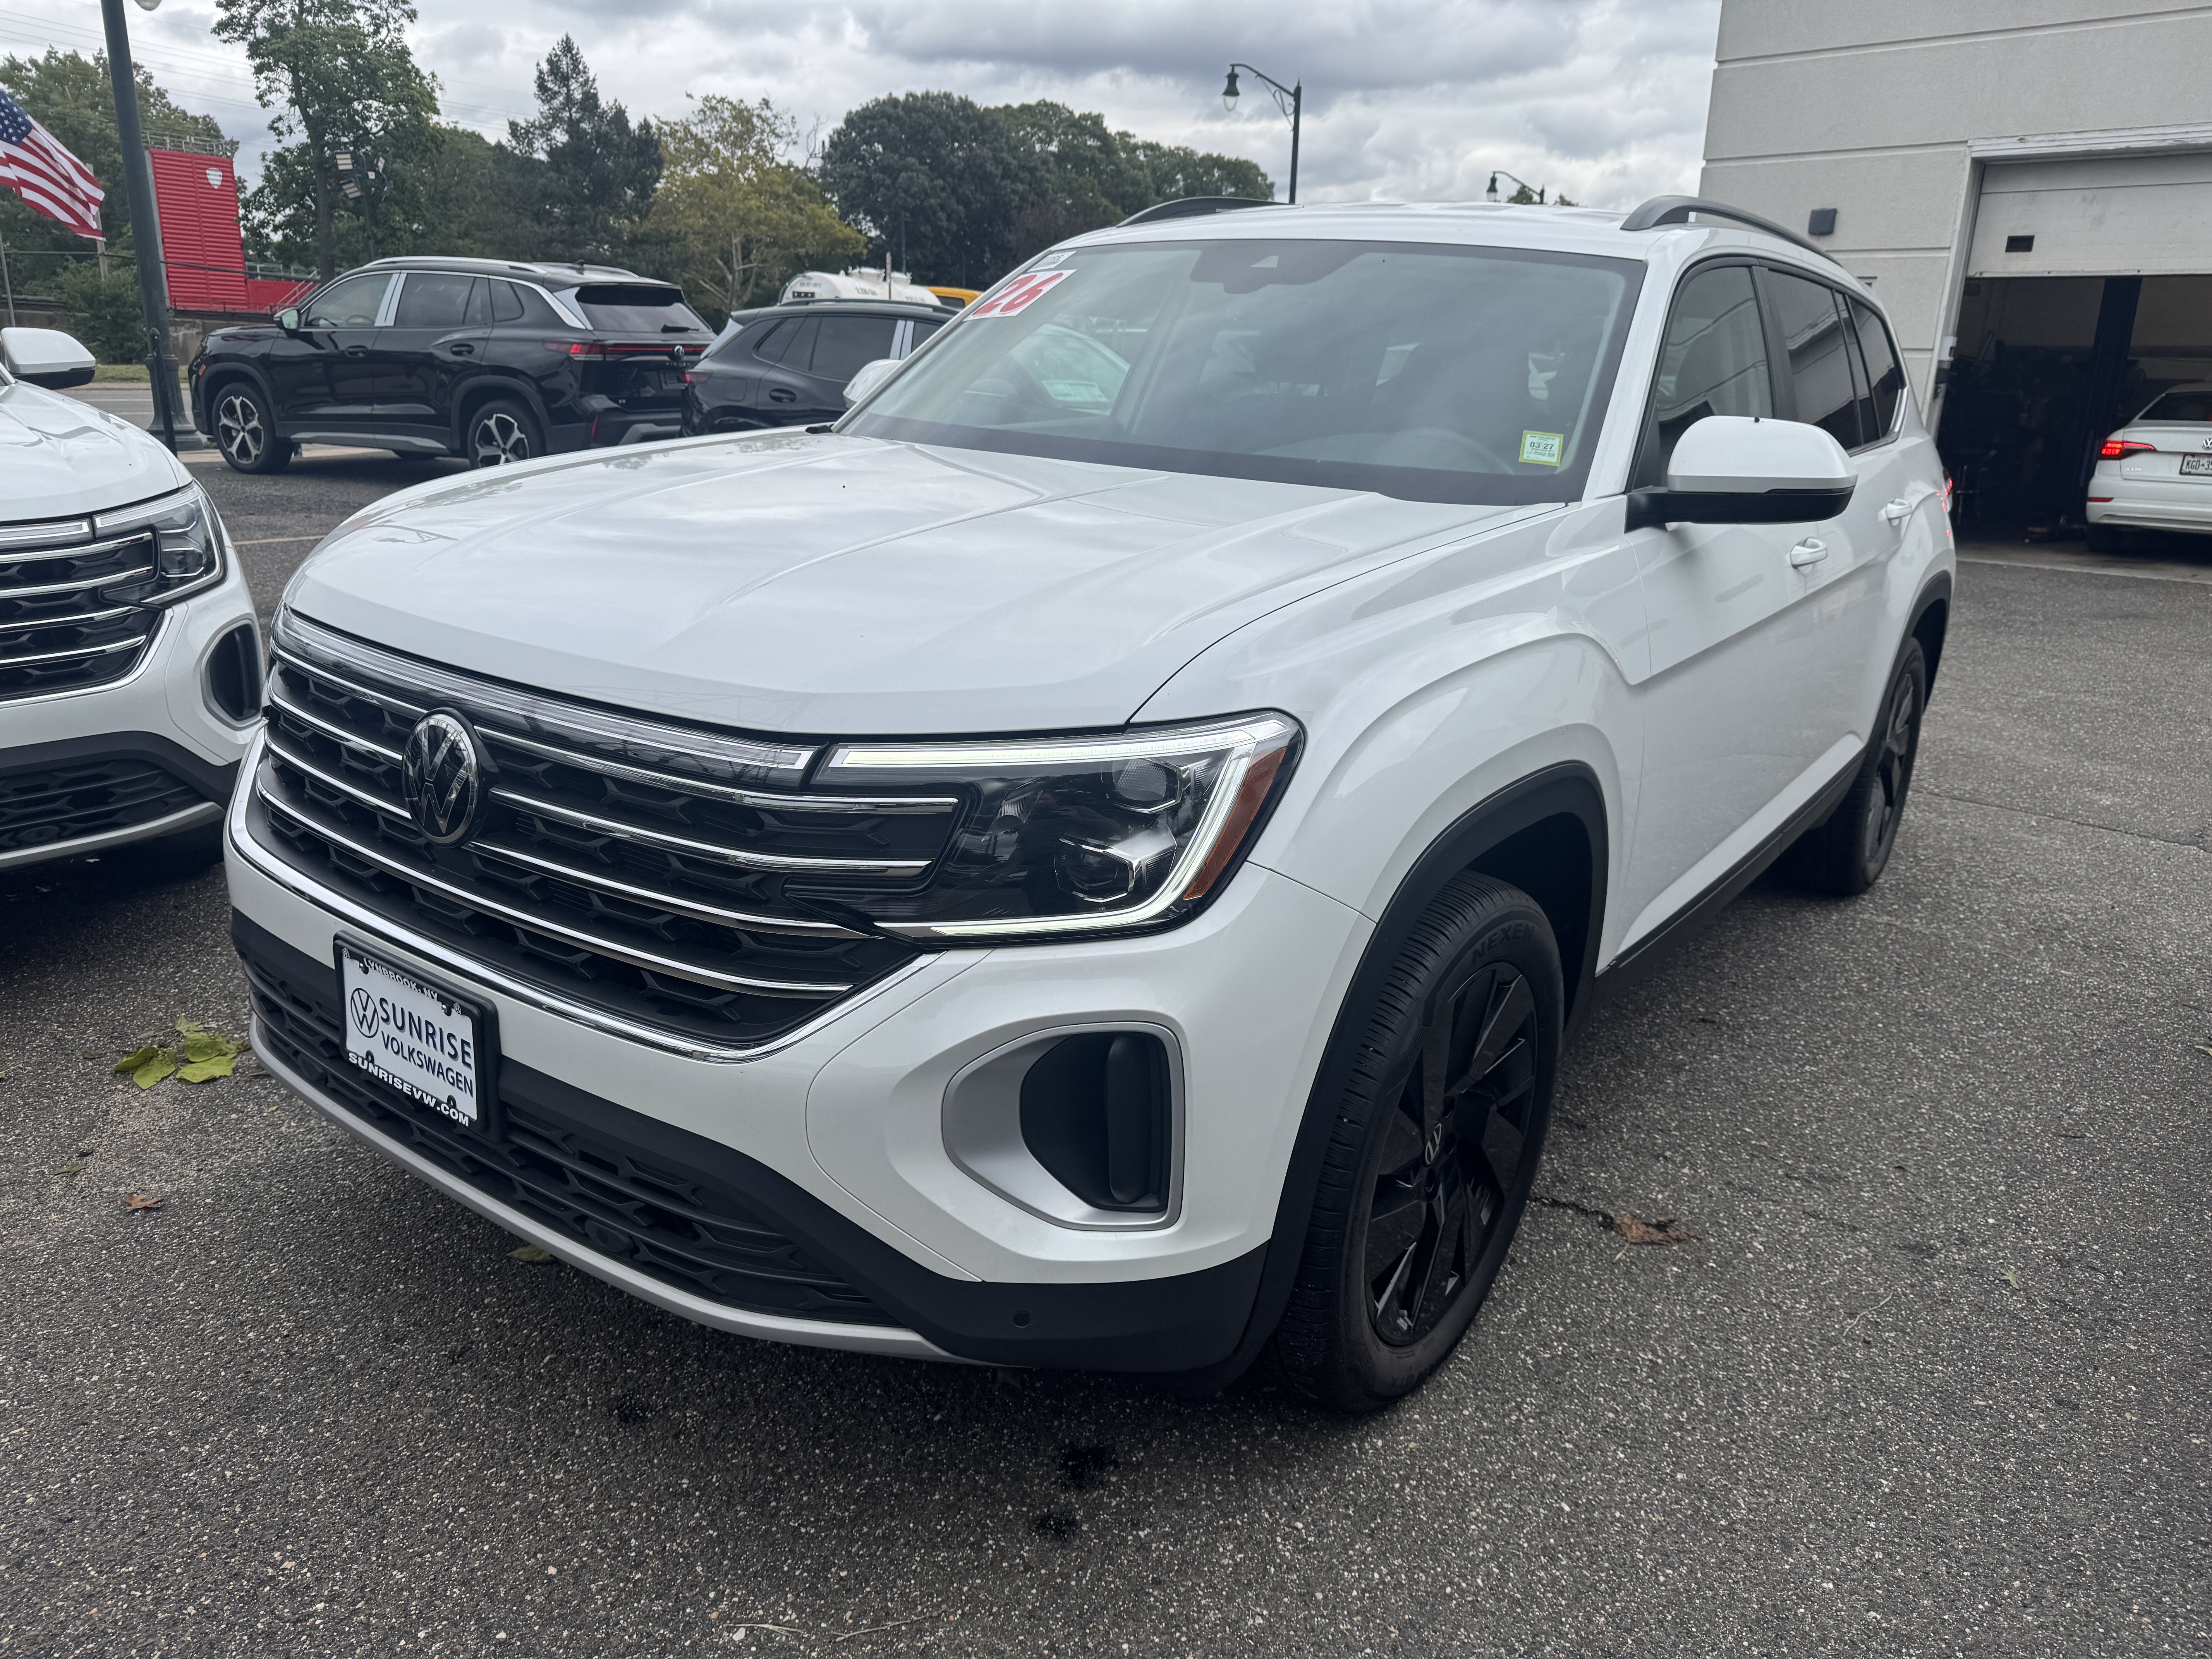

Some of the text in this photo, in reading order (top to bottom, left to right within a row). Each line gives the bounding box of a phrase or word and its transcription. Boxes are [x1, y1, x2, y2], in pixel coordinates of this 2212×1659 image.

[971, 272, 1063, 316] 26
[1472, 923, 1535, 964] NEXEN
[363, 957, 438, 1001] LYNBROOK, NY
[379, 997, 473, 1070] SUNRISE
[349, 1052, 469, 1127] SUNRISEVW.COM
[381, 1030, 473, 1097] VOLKSWAGEN
